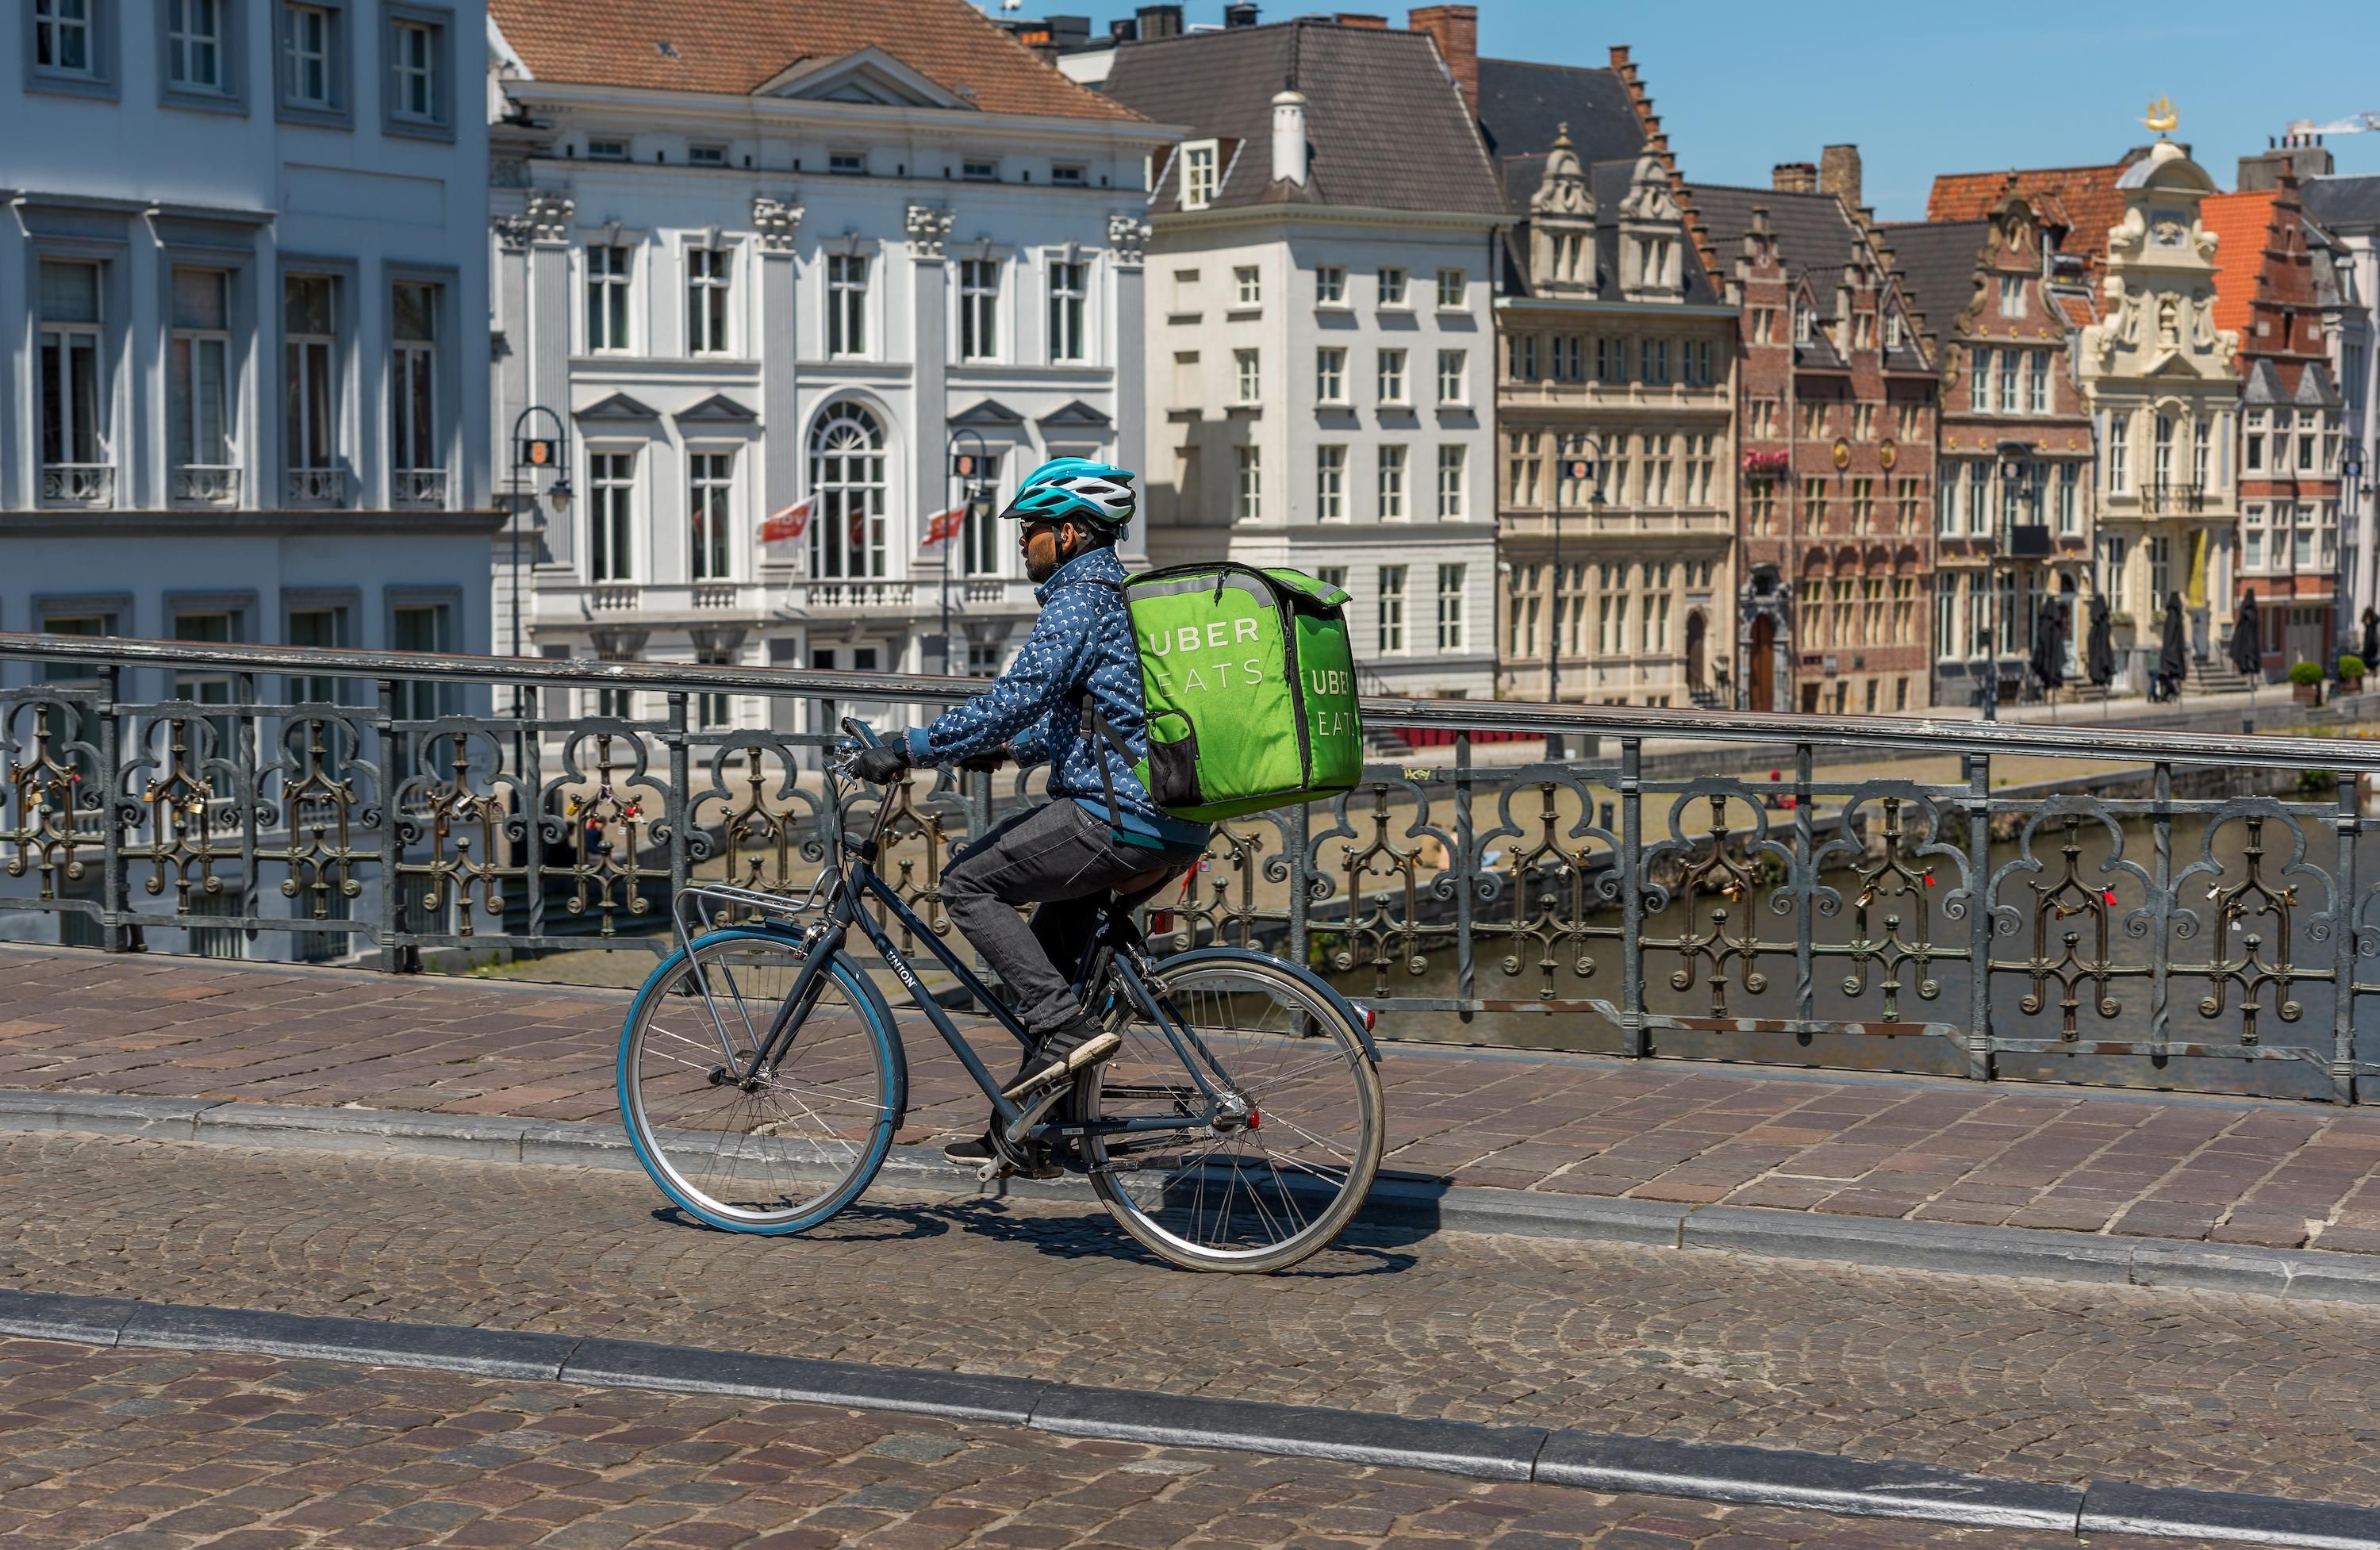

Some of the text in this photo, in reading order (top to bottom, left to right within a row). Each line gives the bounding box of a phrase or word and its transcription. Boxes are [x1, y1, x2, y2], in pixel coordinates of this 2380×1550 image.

[1150, 617, 1259, 657] UBER
[1157, 659, 1263, 698] EATS
[1312, 669, 1349, 695] UBE
[885, 950, 916, 988] UNION
